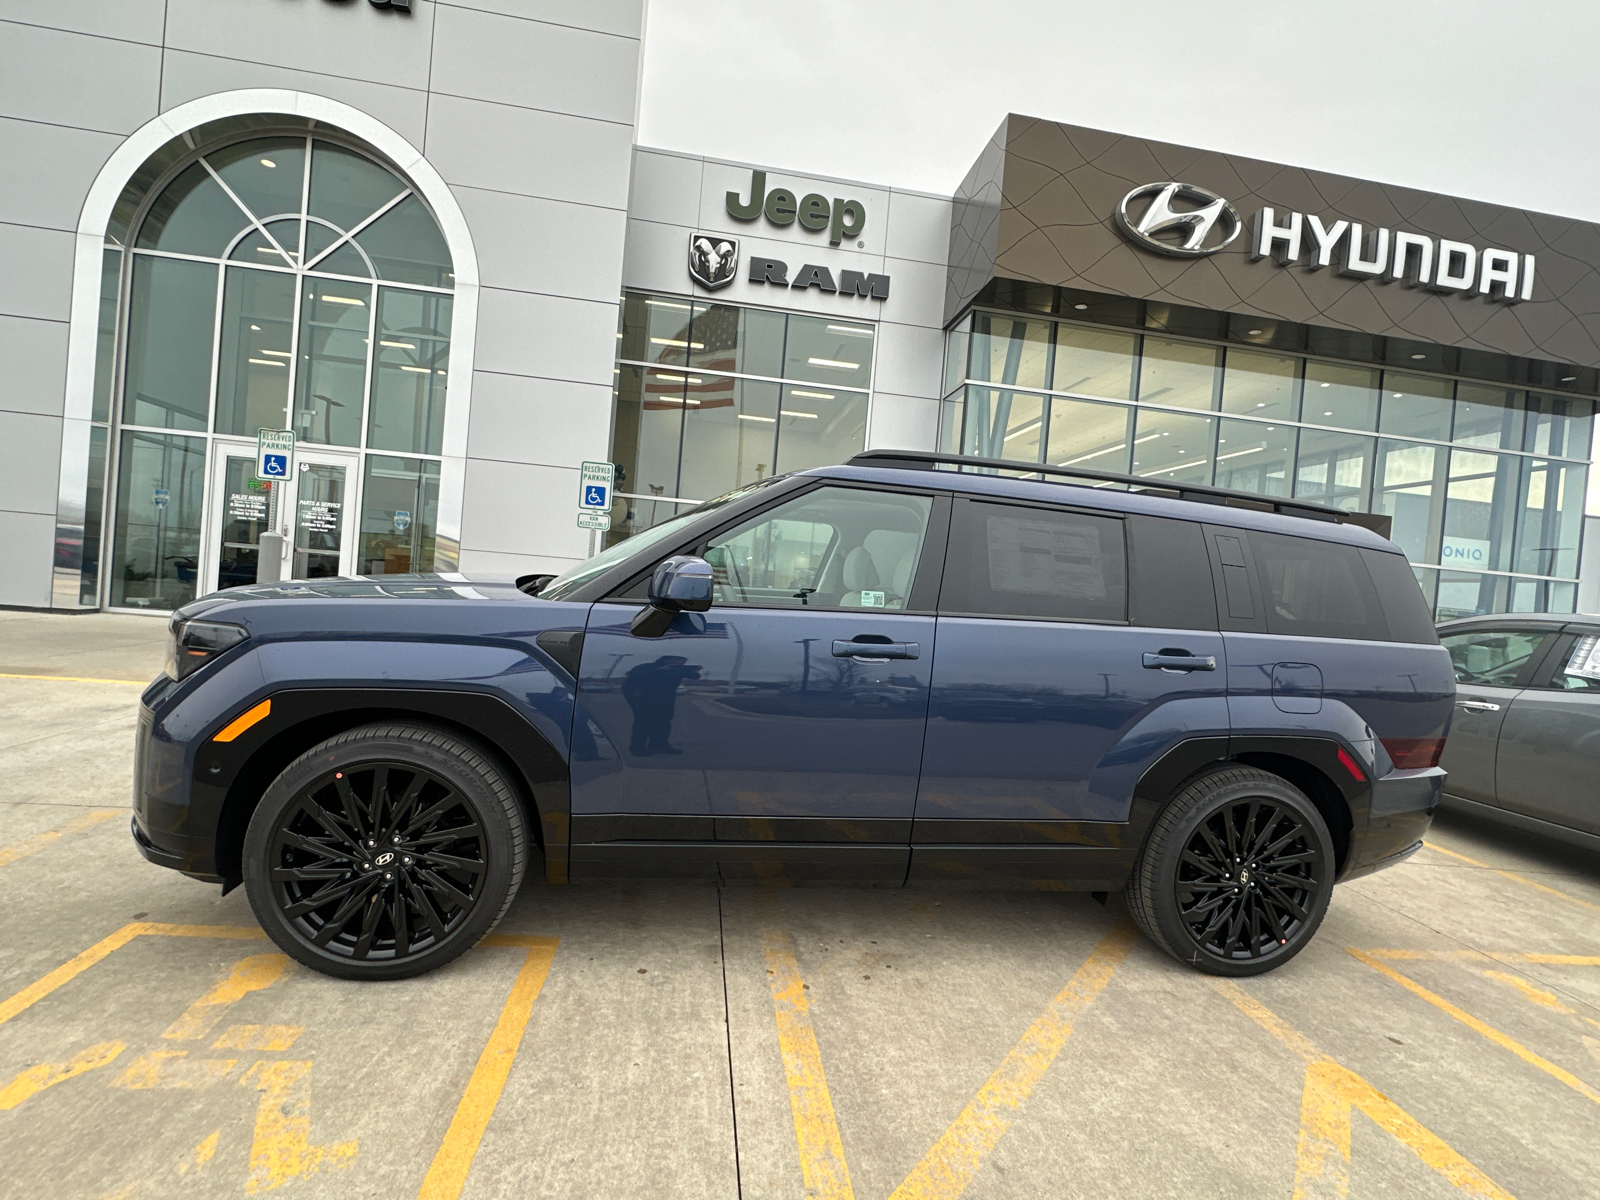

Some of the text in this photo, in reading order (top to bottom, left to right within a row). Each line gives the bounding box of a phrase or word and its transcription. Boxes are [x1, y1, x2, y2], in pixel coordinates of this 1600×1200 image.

[726, 169, 866, 245] Jeep
[1252, 206, 1535, 301] HYUNDAI
[748, 256, 891, 300] RAM
[262, 433, 292, 442] RESERVED
[261, 442, 292, 451] PARKING
[584, 466, 610, 474] RESERVED
[583, 474, 610, 482] PARKING
[579, 520, 608, 528] ACCESSIBLE
